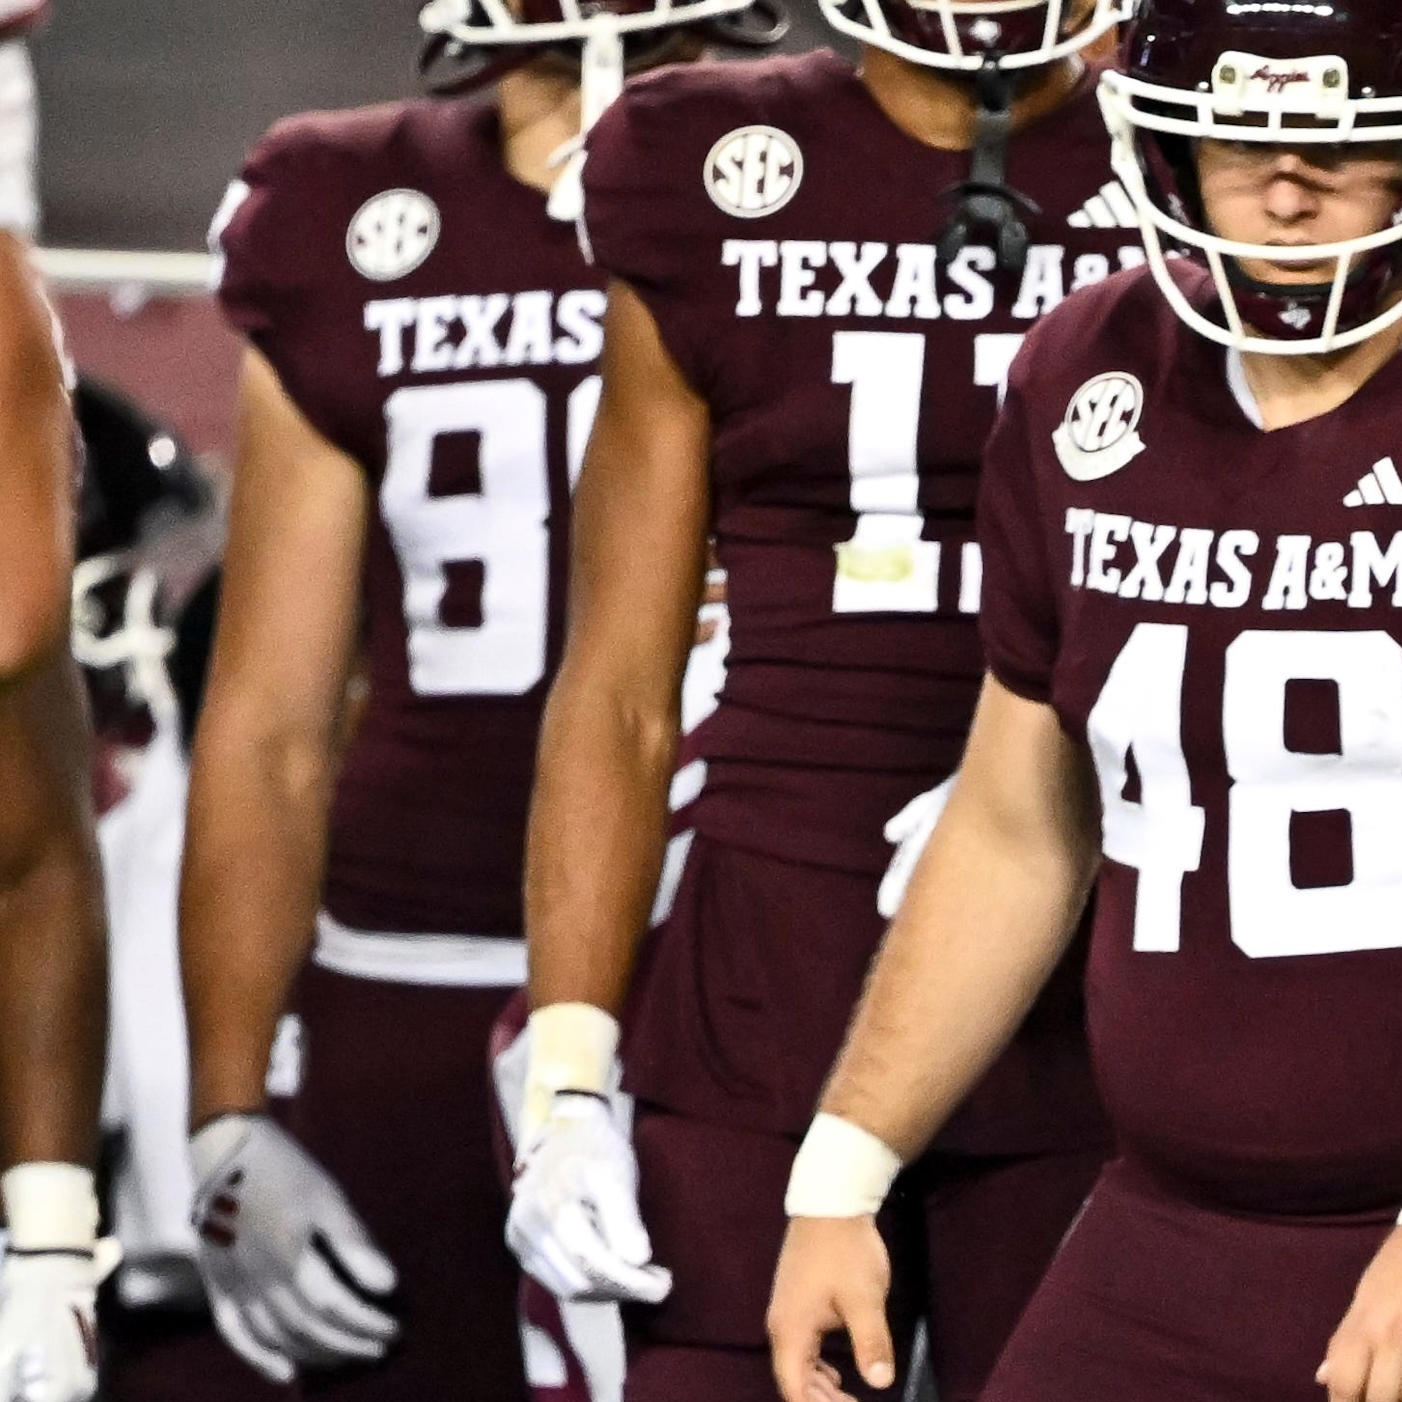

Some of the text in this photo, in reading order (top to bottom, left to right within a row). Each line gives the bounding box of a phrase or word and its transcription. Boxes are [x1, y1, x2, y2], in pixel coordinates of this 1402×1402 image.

[708, 128, 800, 215] SEC
[721, 239, 992, 320] TEXAS
[363, 290, 608, 378] TEXAS
[1065, 373, 1143, 452] SEC
[380, 375, 603, 696] 8
[1065, 507, 1259, 608] TEXAS
